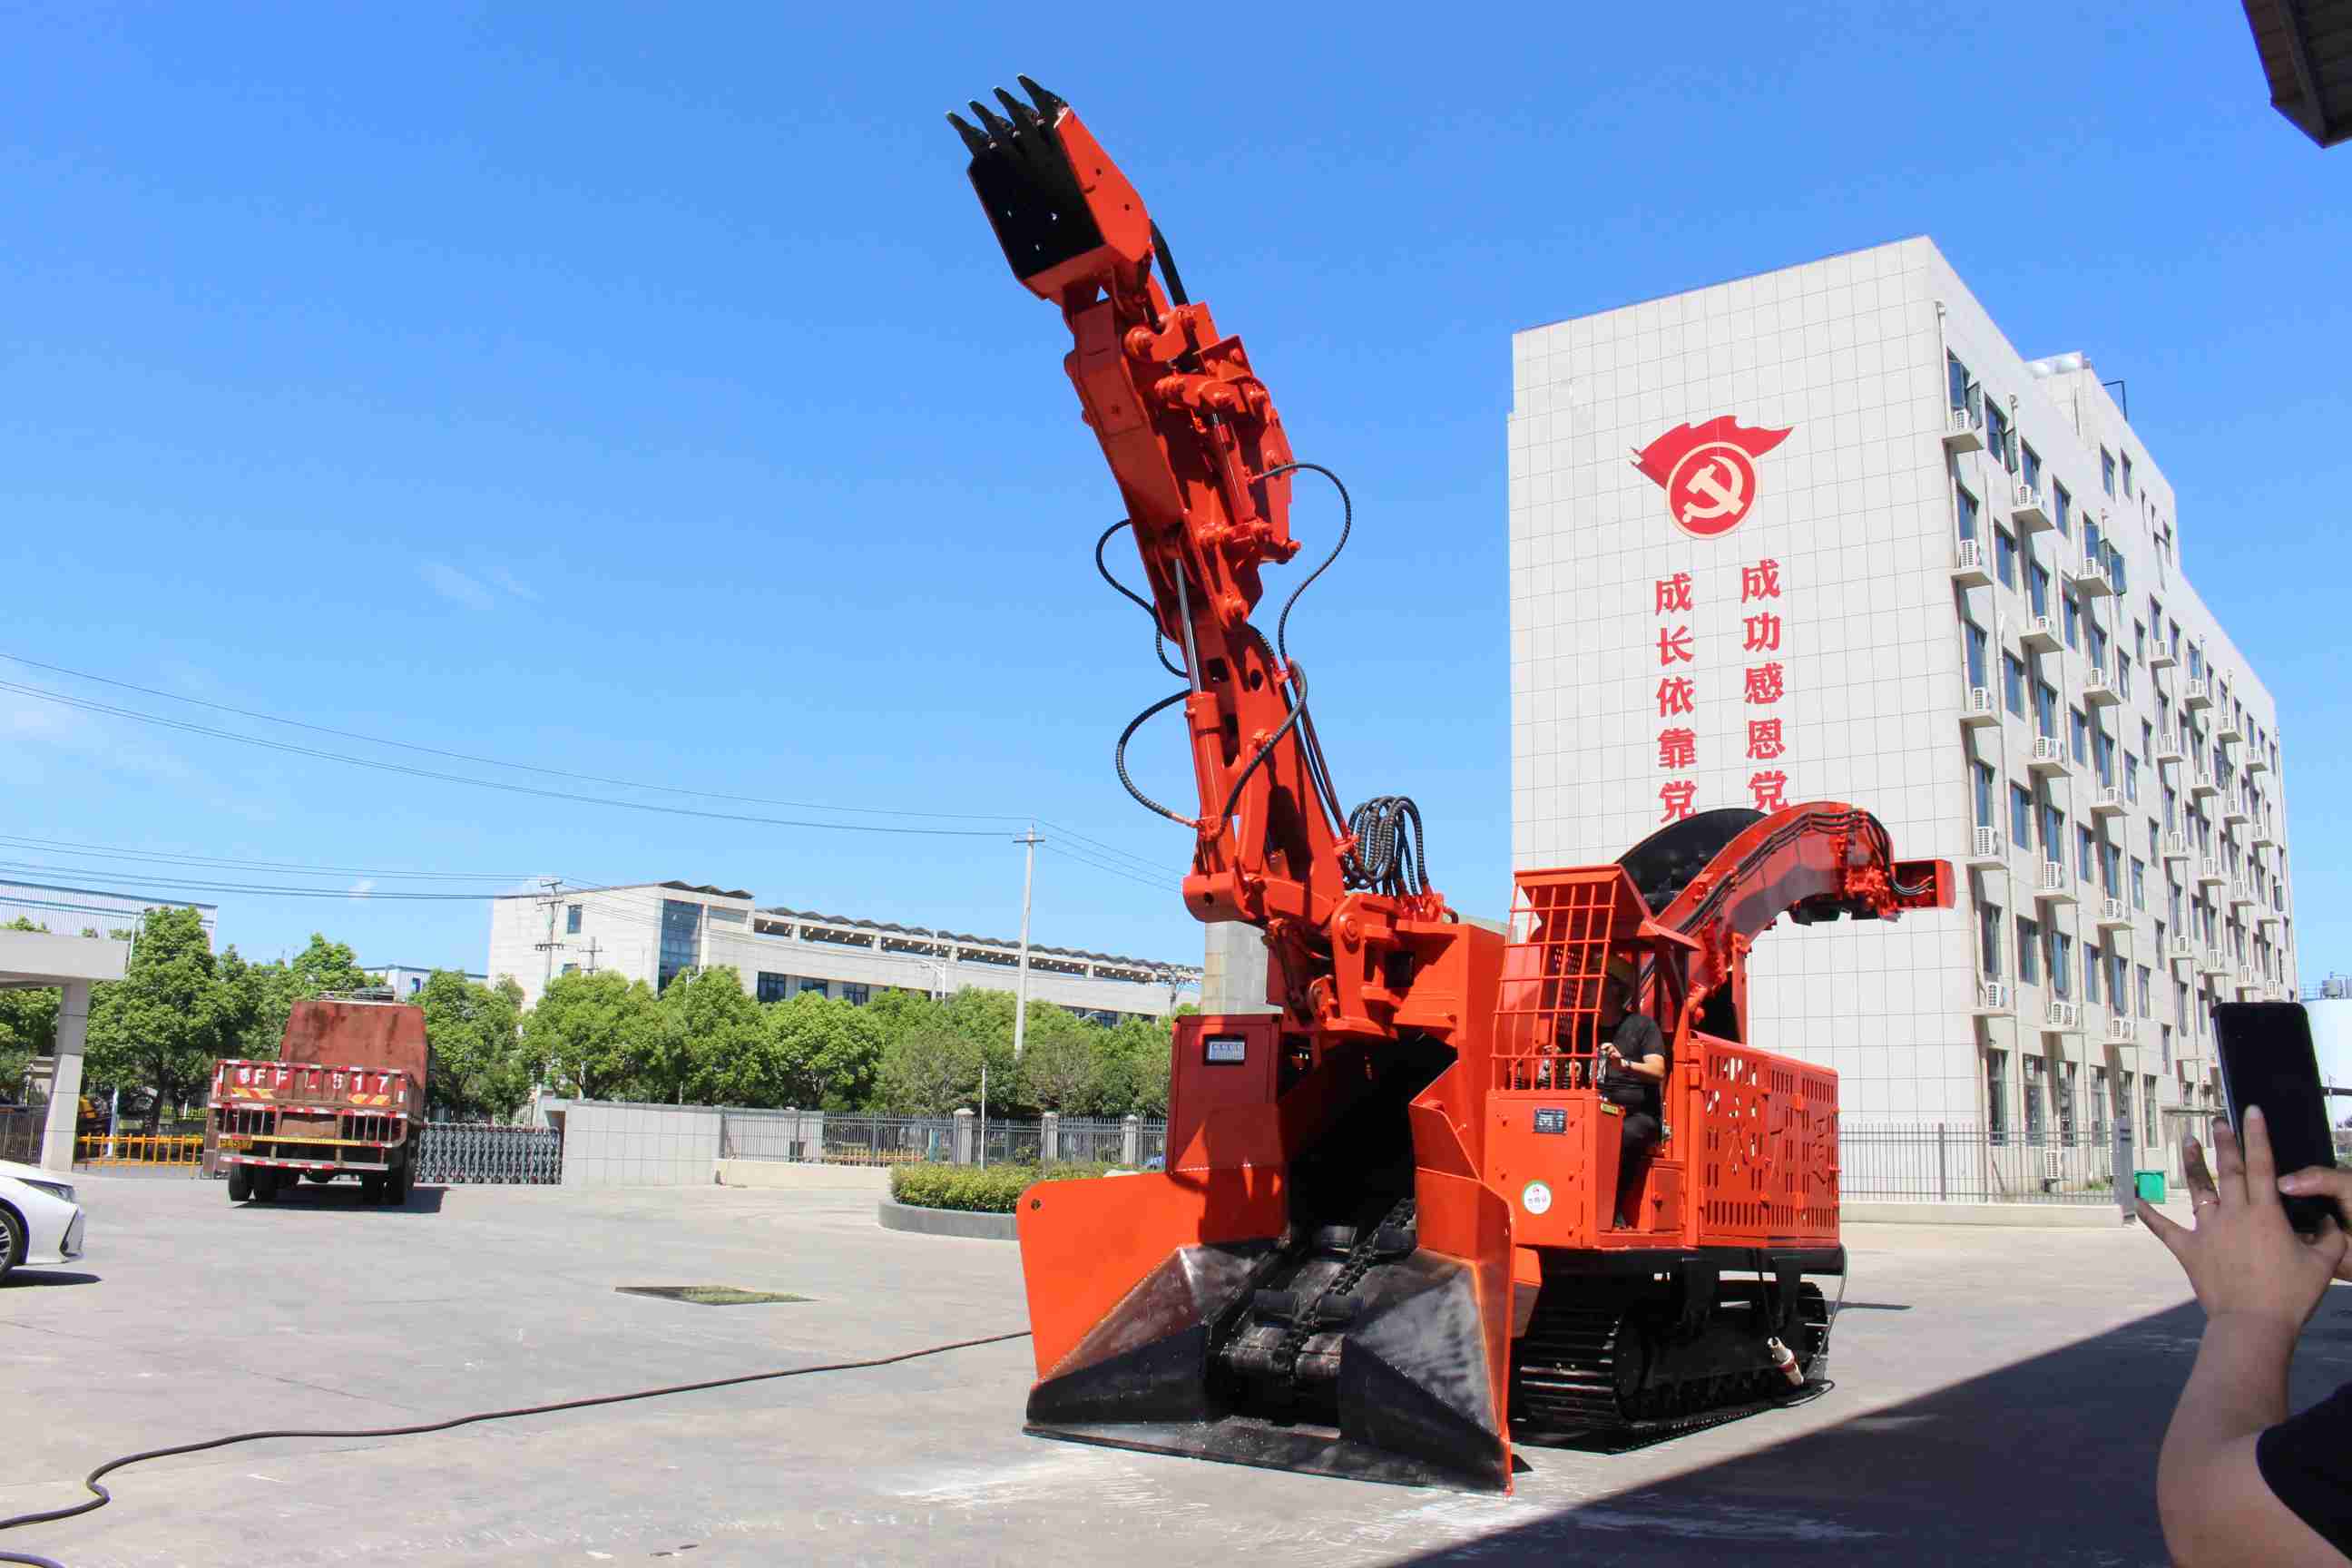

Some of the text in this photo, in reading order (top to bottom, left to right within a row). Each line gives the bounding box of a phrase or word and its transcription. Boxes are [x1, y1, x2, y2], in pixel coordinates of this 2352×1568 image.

[1655, 572, 1698, 824] 成长依靠党
[1741, 558, 1788, 814] 成功感恩党
